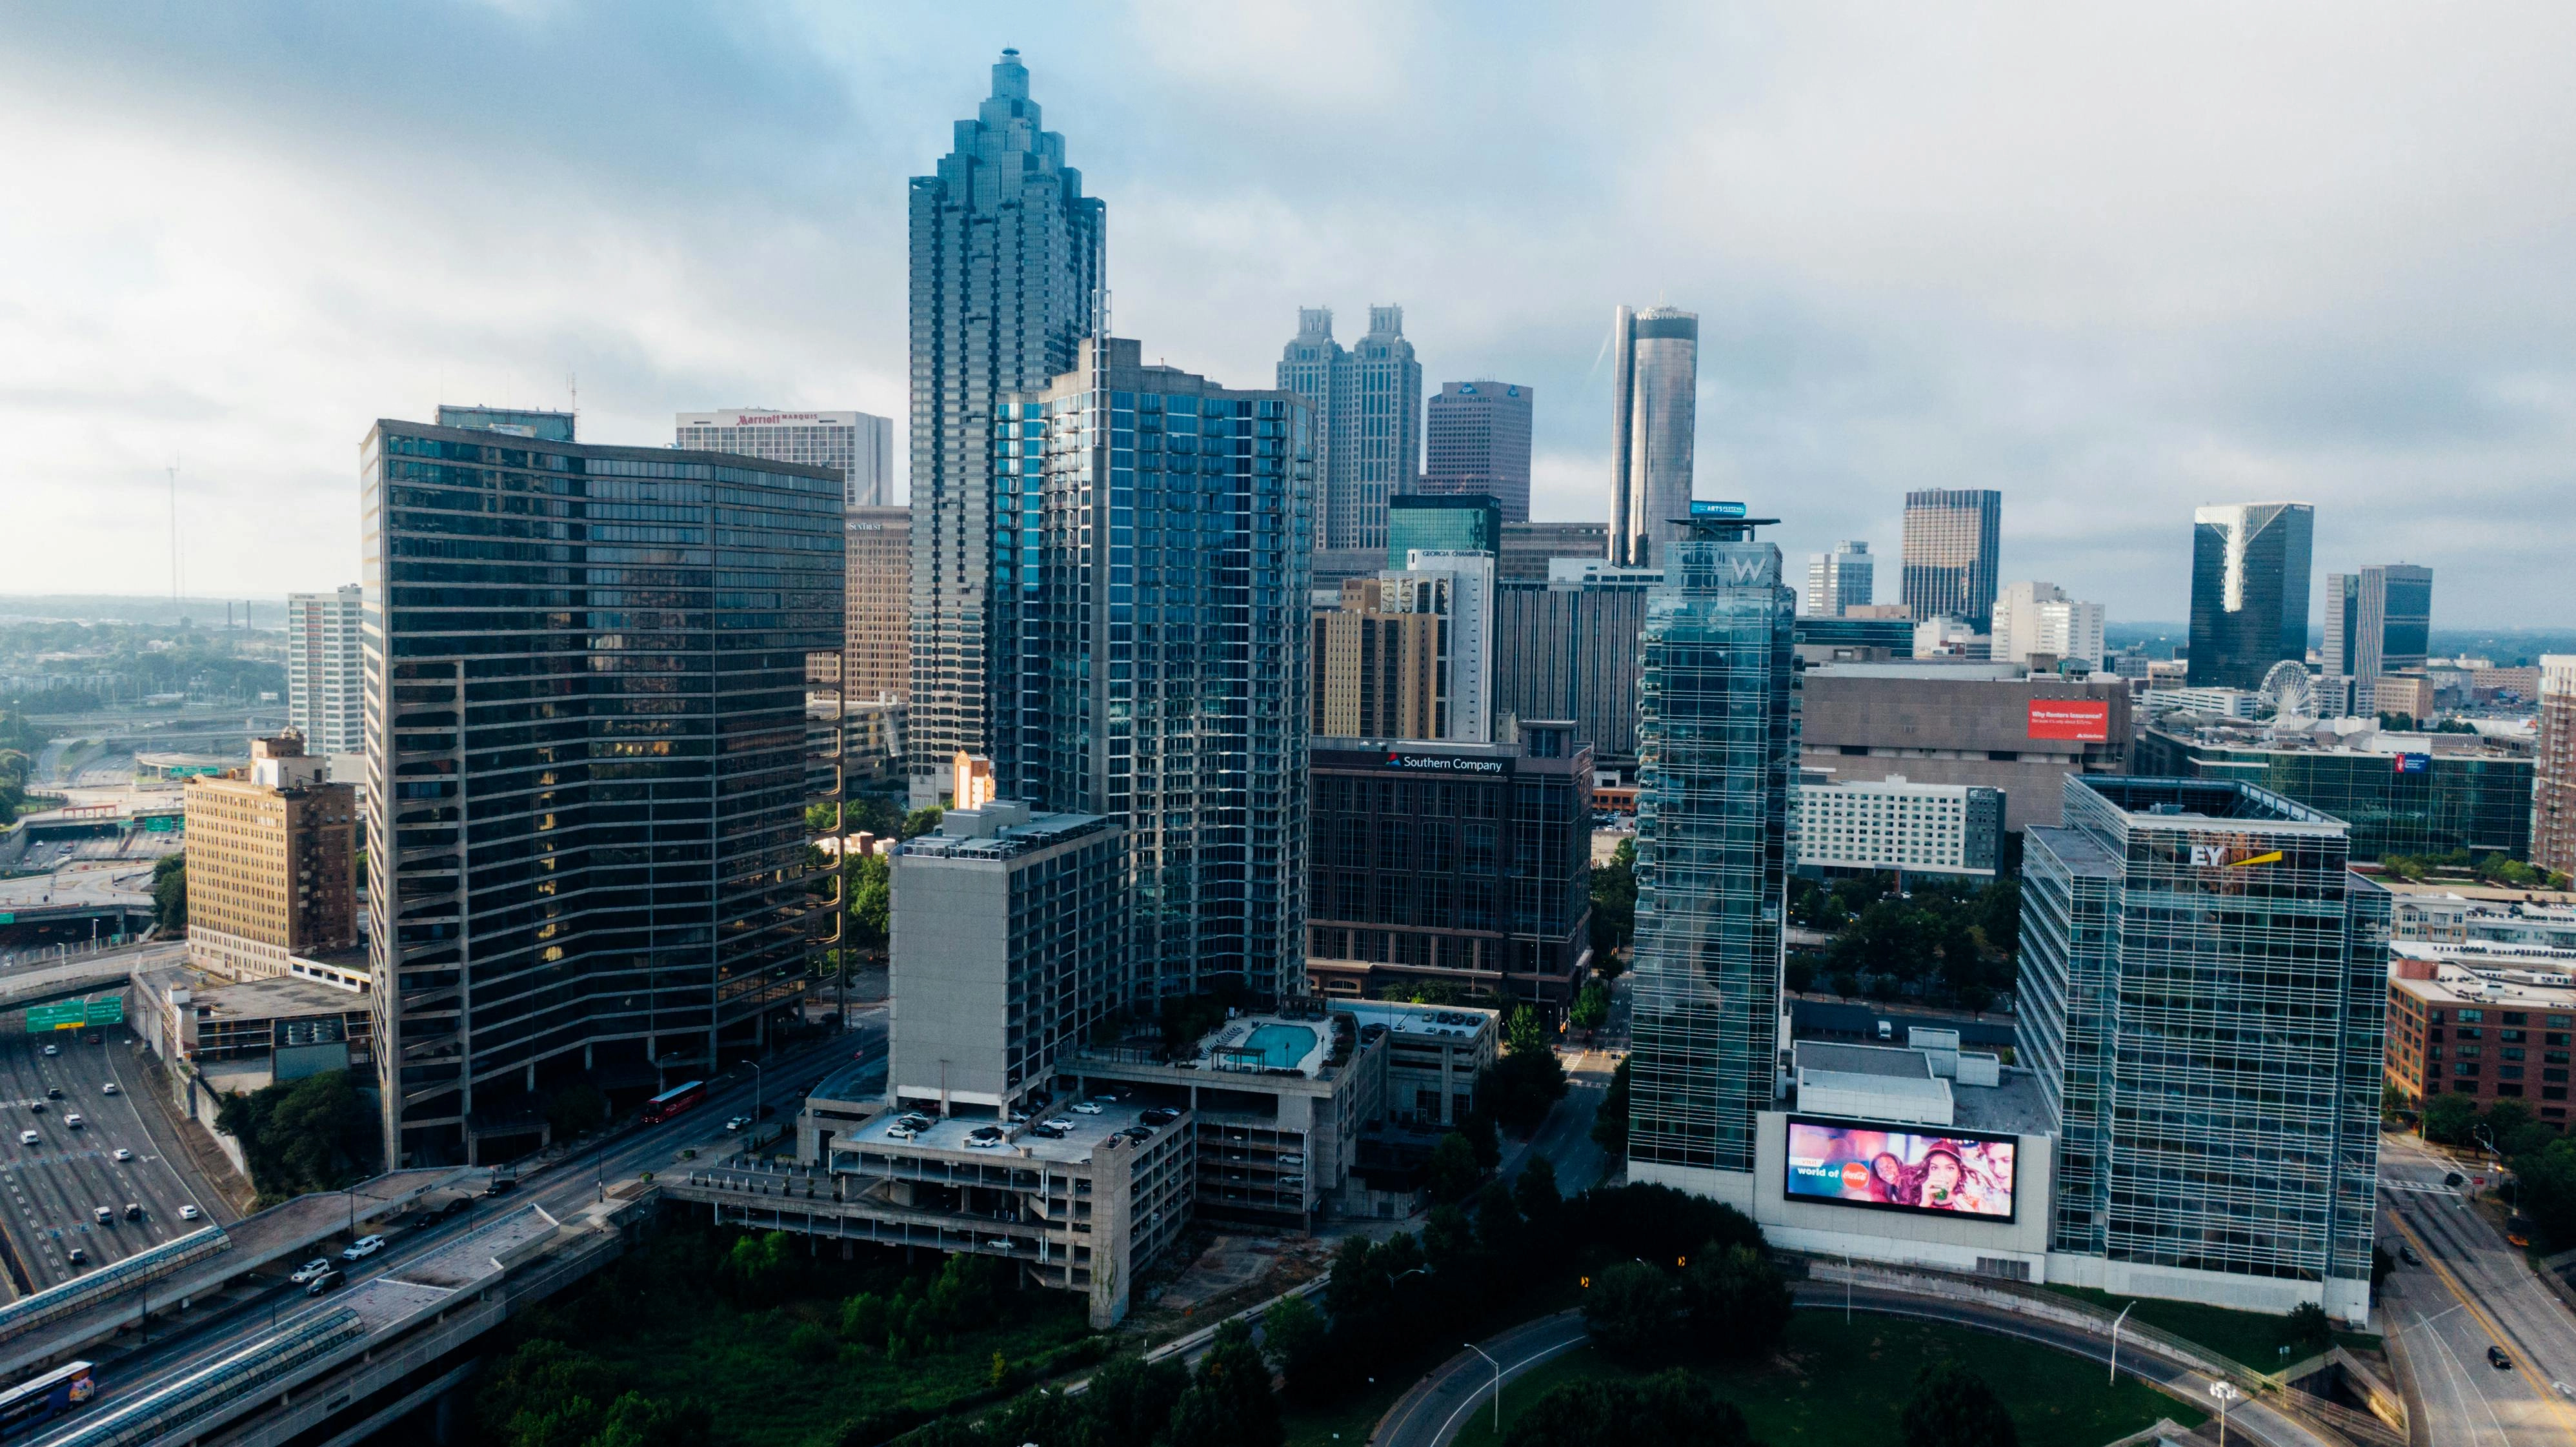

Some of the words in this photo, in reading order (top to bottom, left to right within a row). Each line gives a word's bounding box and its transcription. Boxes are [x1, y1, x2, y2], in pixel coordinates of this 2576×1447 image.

[1636, 309, 1678, 320] WESTIN
[736, 415, 780, 426] Marriott
[1731, 558, 1767, 582] W
[1404, 756, 1451, 769] Southern
[1453, 758, 1502, 773] Company
[2191, 846, 2224, 866] EY
[1797, 1167, 1826, 1177] world
[1827, 1169, 1840, 1179] of
